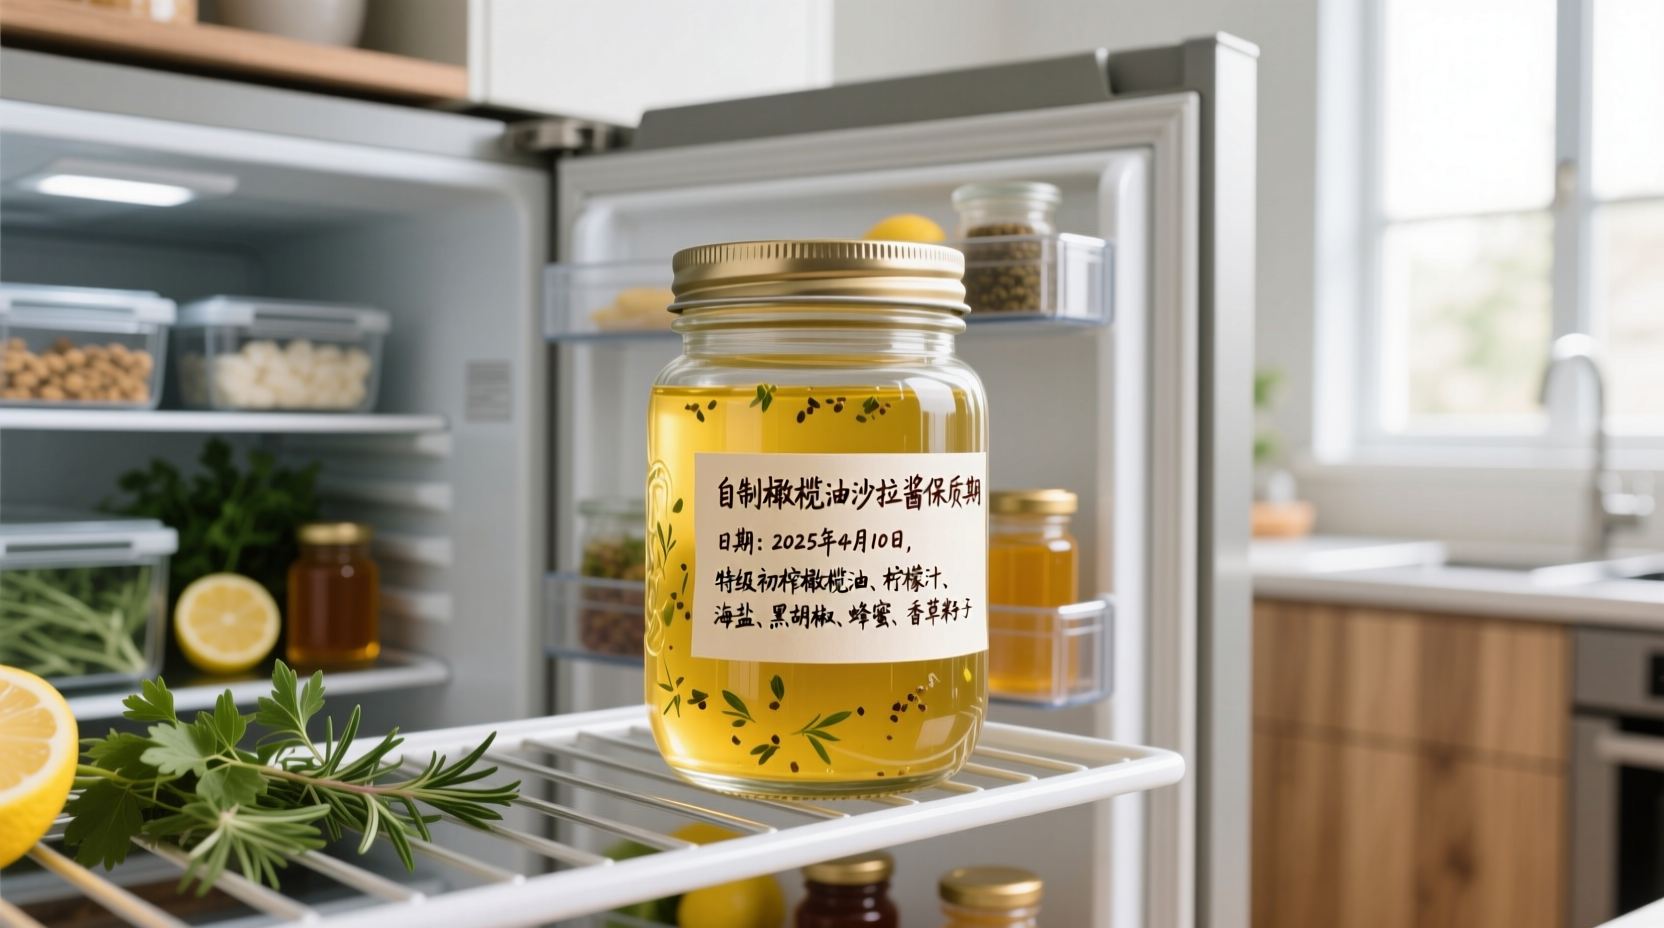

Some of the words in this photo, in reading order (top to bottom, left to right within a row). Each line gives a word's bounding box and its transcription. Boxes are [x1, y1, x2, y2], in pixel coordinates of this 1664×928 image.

[717, 473, 981, 512] 自制橄榄油沙拉酱保质期
